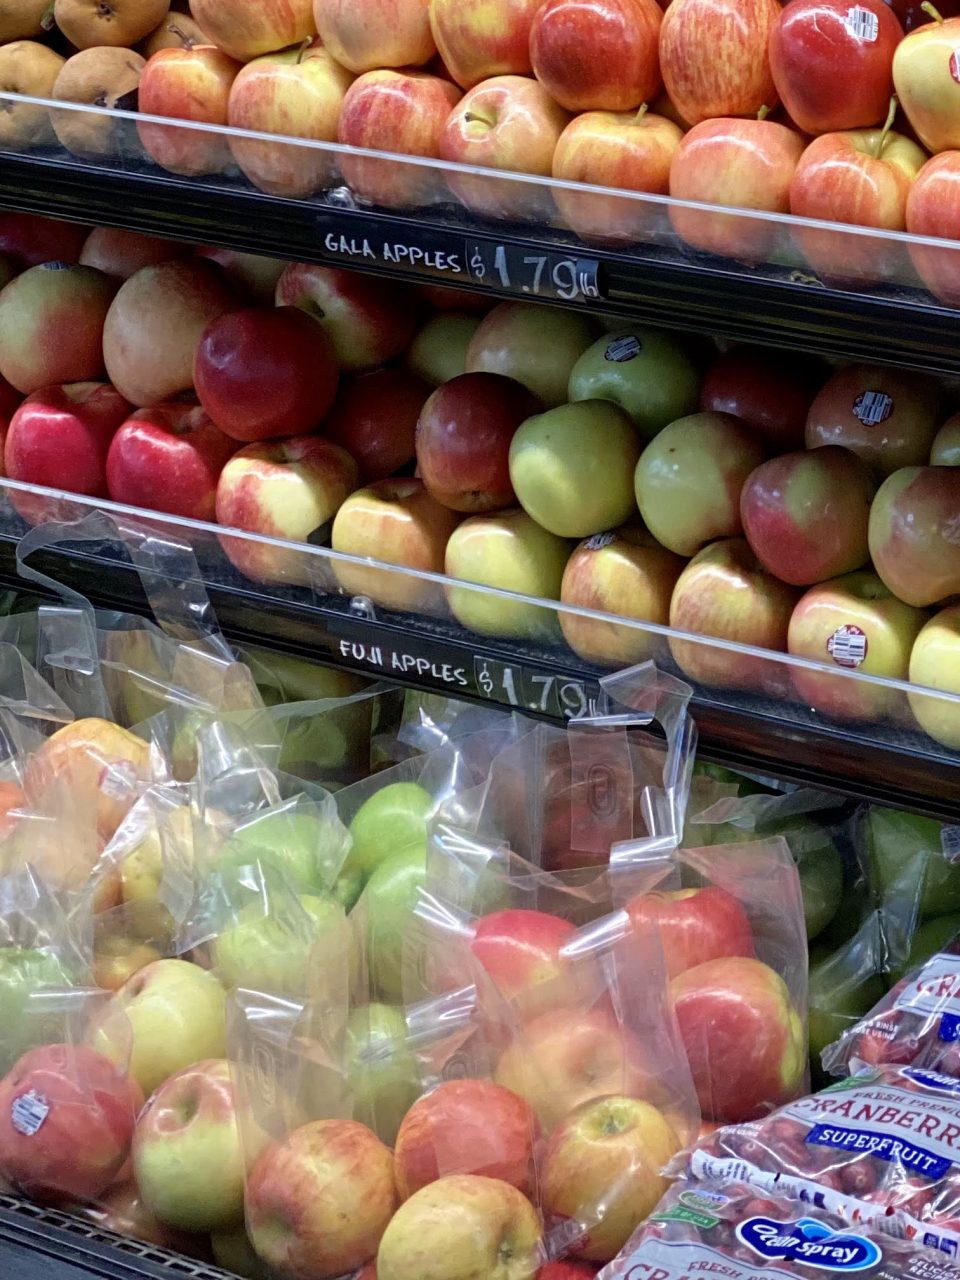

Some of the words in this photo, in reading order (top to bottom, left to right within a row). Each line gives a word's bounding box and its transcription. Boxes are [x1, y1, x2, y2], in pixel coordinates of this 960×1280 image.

[325, 233, 376, 259] GALA
[383, 242, 461, 272] APPLES
[339, 639, 383, 667] FUJI
[391, 652, 468, 686] APPLES
[853, 1091, 908, 1106] FRESH
[818, 1128, 937, 1170] SUPERFRUIT
[795, 1239, 862, 1264] Spray
[688, 1261, 743, 1279] FRESH
